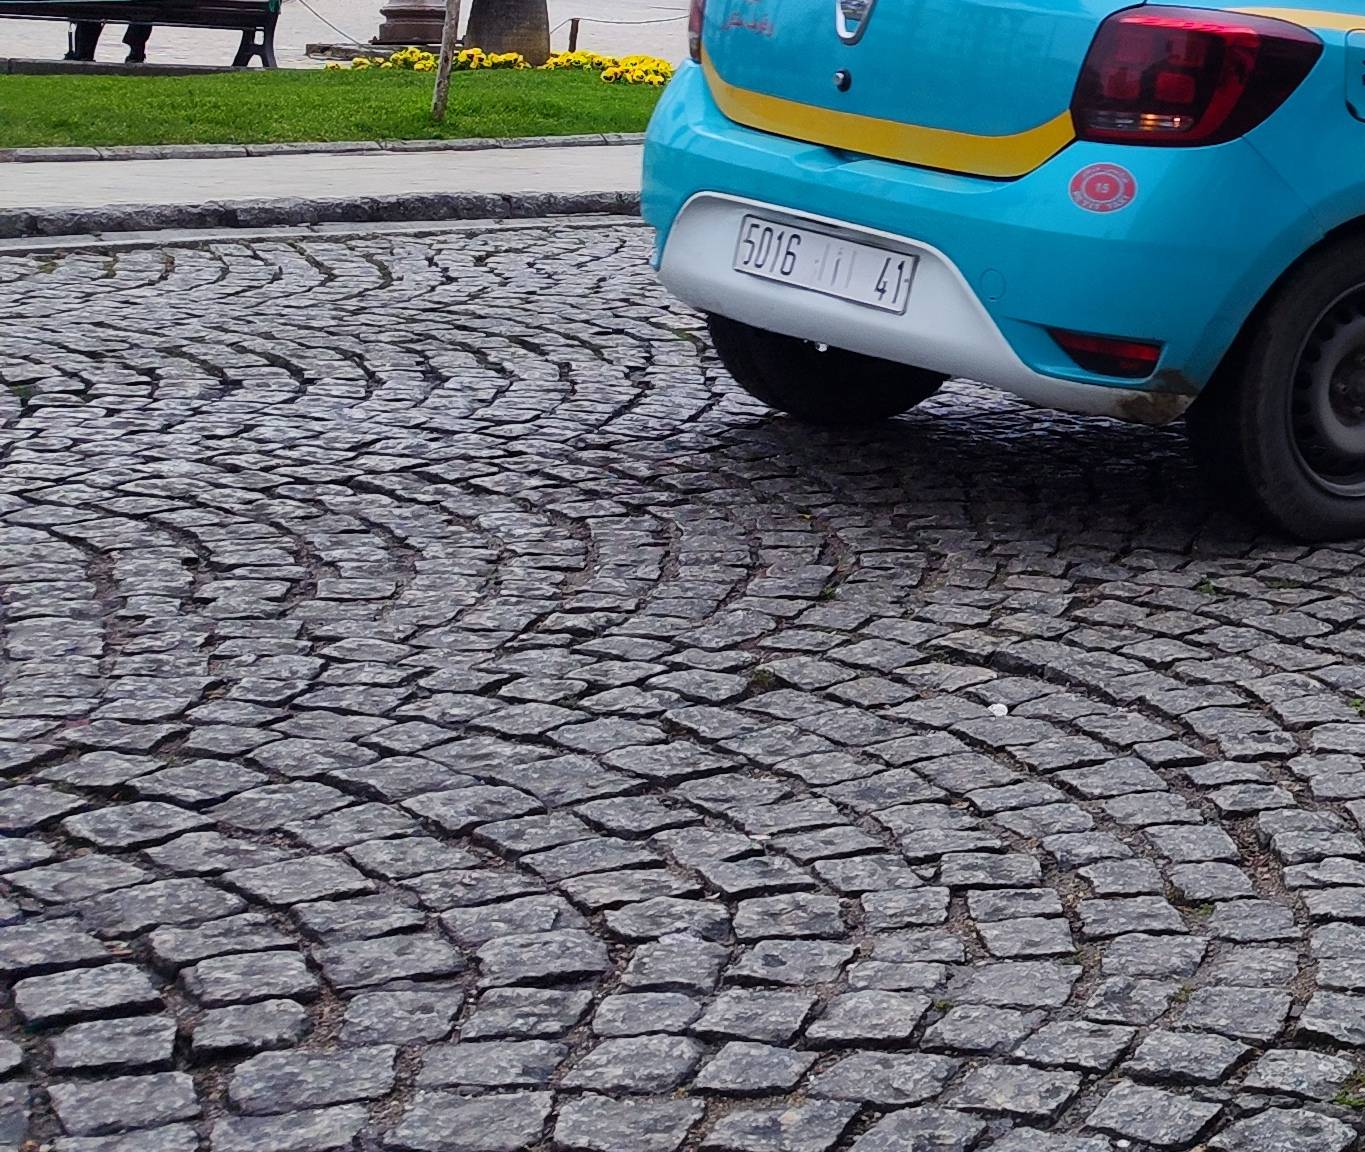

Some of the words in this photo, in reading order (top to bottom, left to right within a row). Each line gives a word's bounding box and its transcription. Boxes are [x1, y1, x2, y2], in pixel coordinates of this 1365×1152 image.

[1095, 182, 1110, 194] 15
[743, 224, 801, 276] 5016
[874, 257, 906, 304] 41
